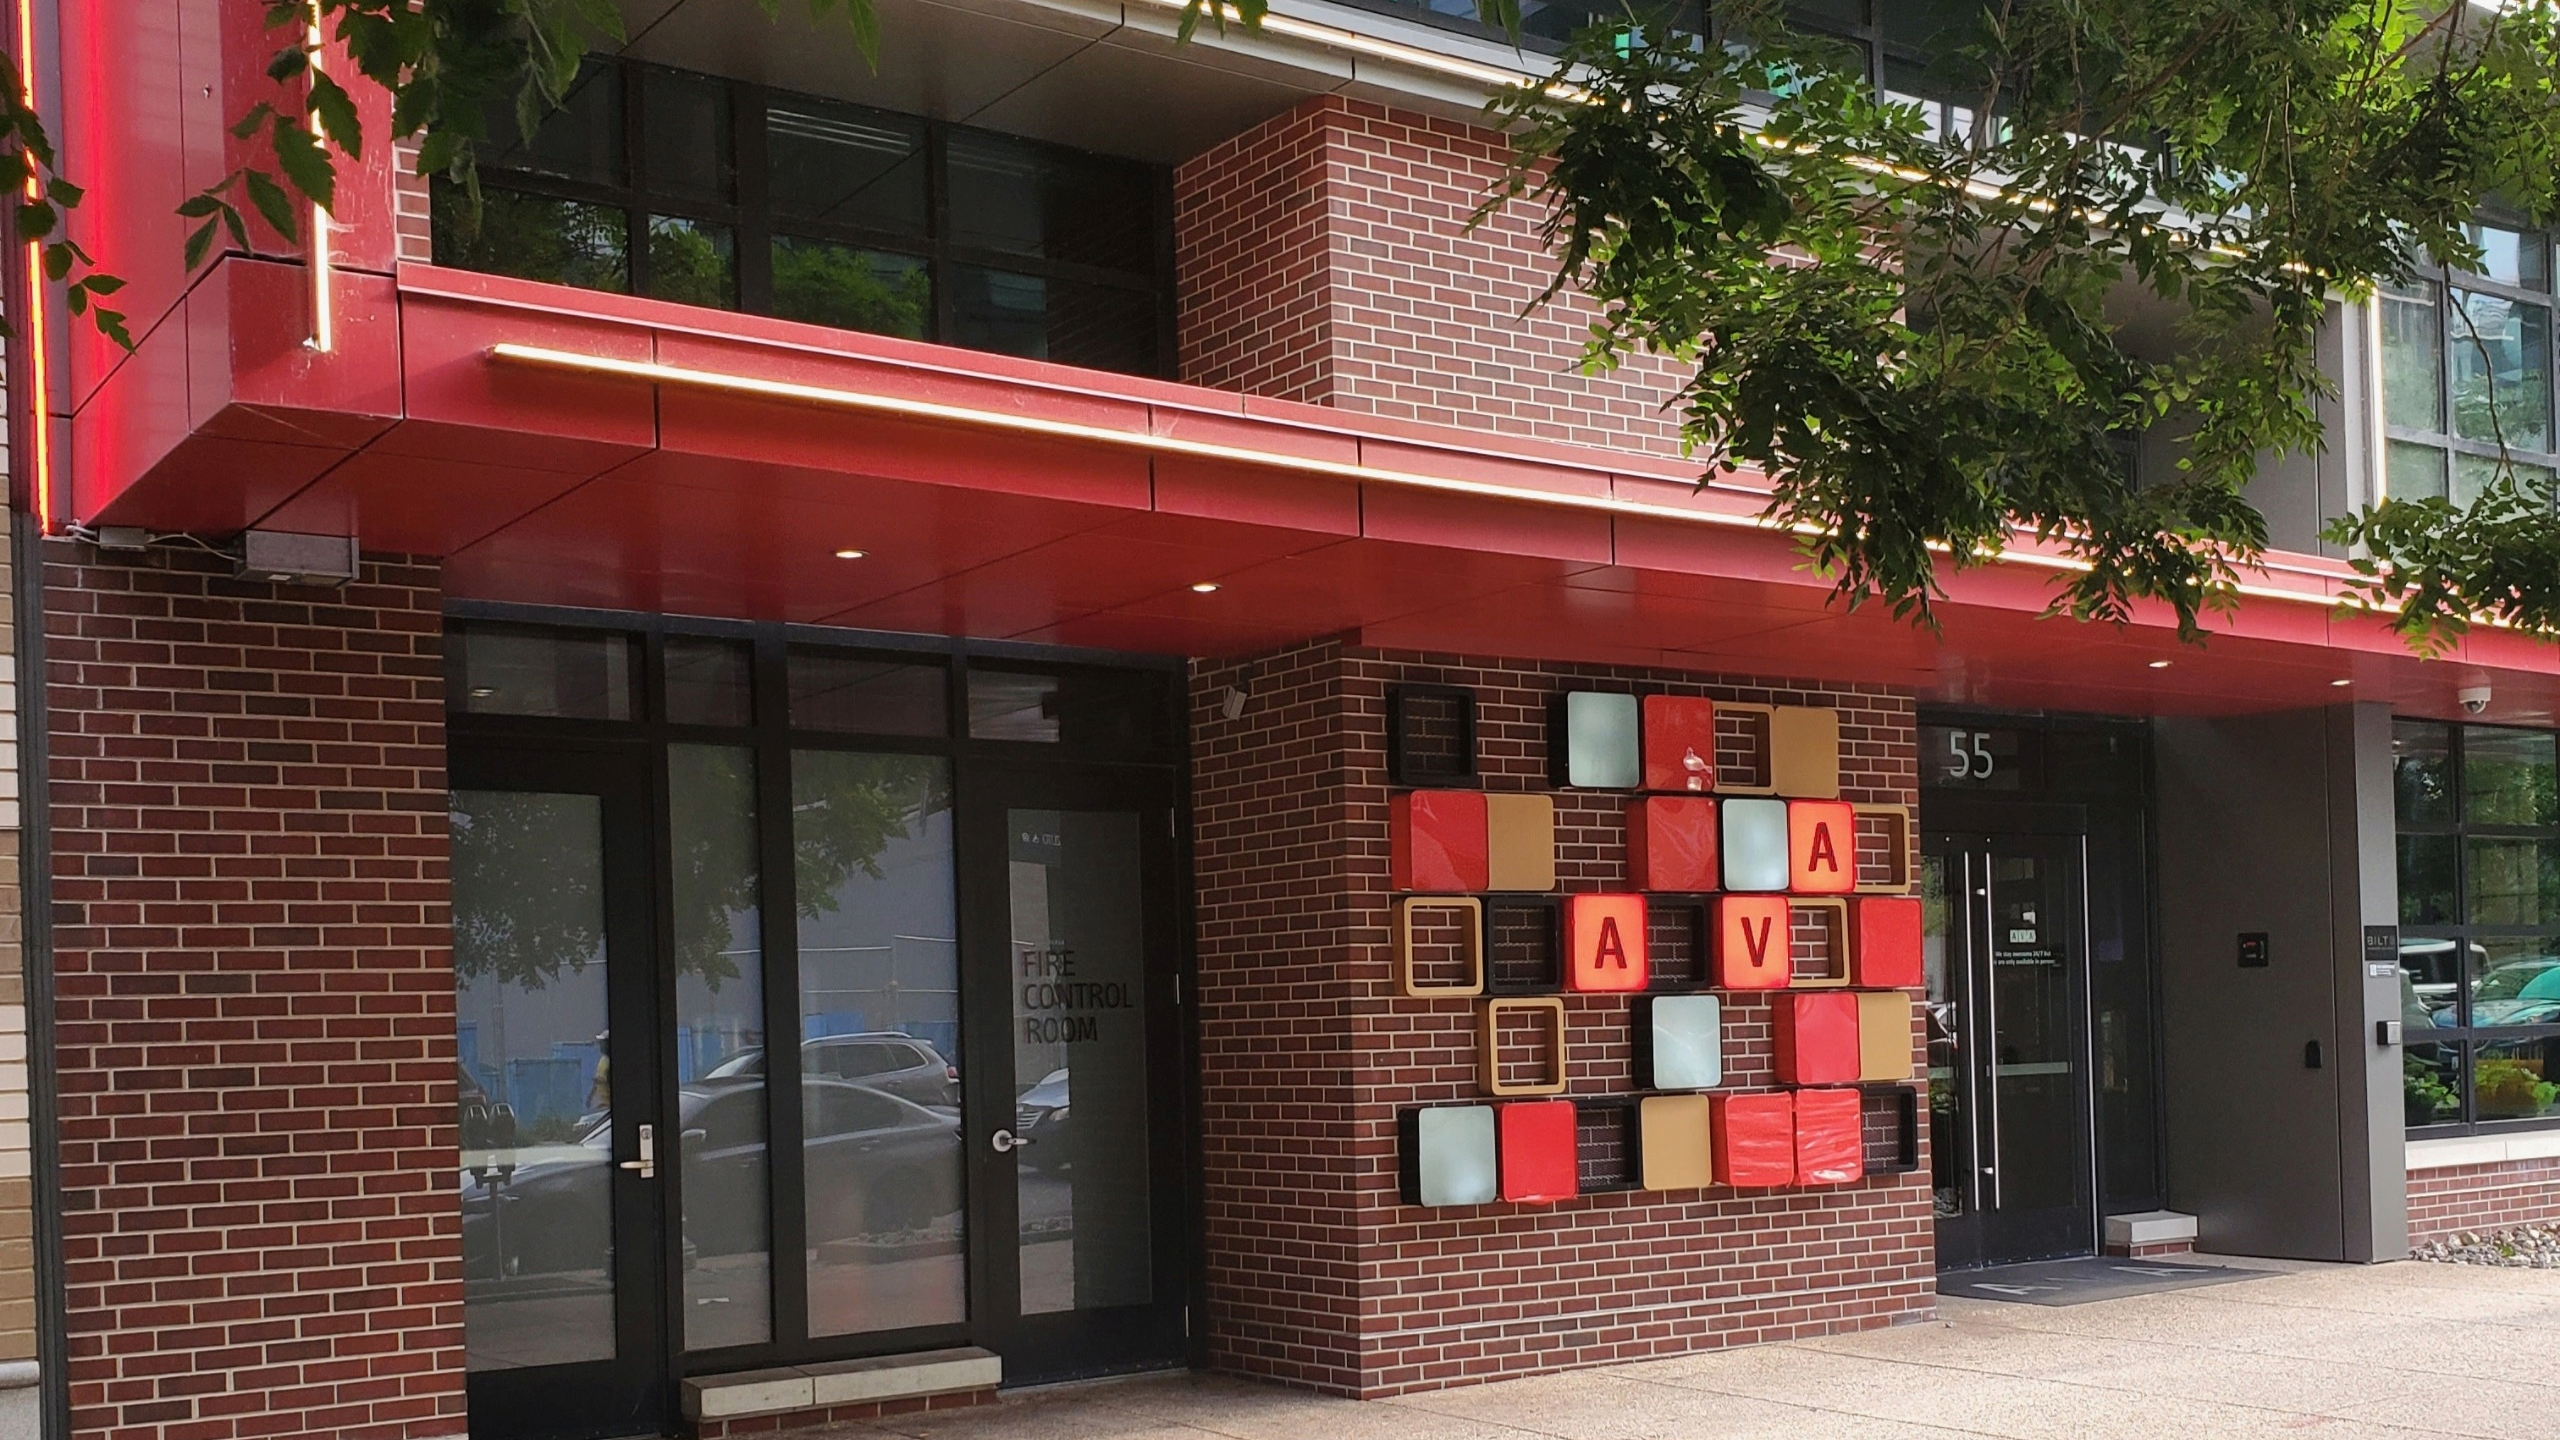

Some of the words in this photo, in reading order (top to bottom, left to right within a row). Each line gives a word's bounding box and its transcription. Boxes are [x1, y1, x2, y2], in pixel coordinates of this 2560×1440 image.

[1950, 731, 1994, 779] 55
[1807, 821, 1839, 872] A
[1594, 916, 1628, 969] A
[1740, 916, 1772, 968] V
[2011, 931, 2034, 941] AVA
[1023, 950, 1076, 977] FIRE
[1023, 982, 1133, 1010] CONTROL
[1026, 1016, 1098, 1044] ROOM
